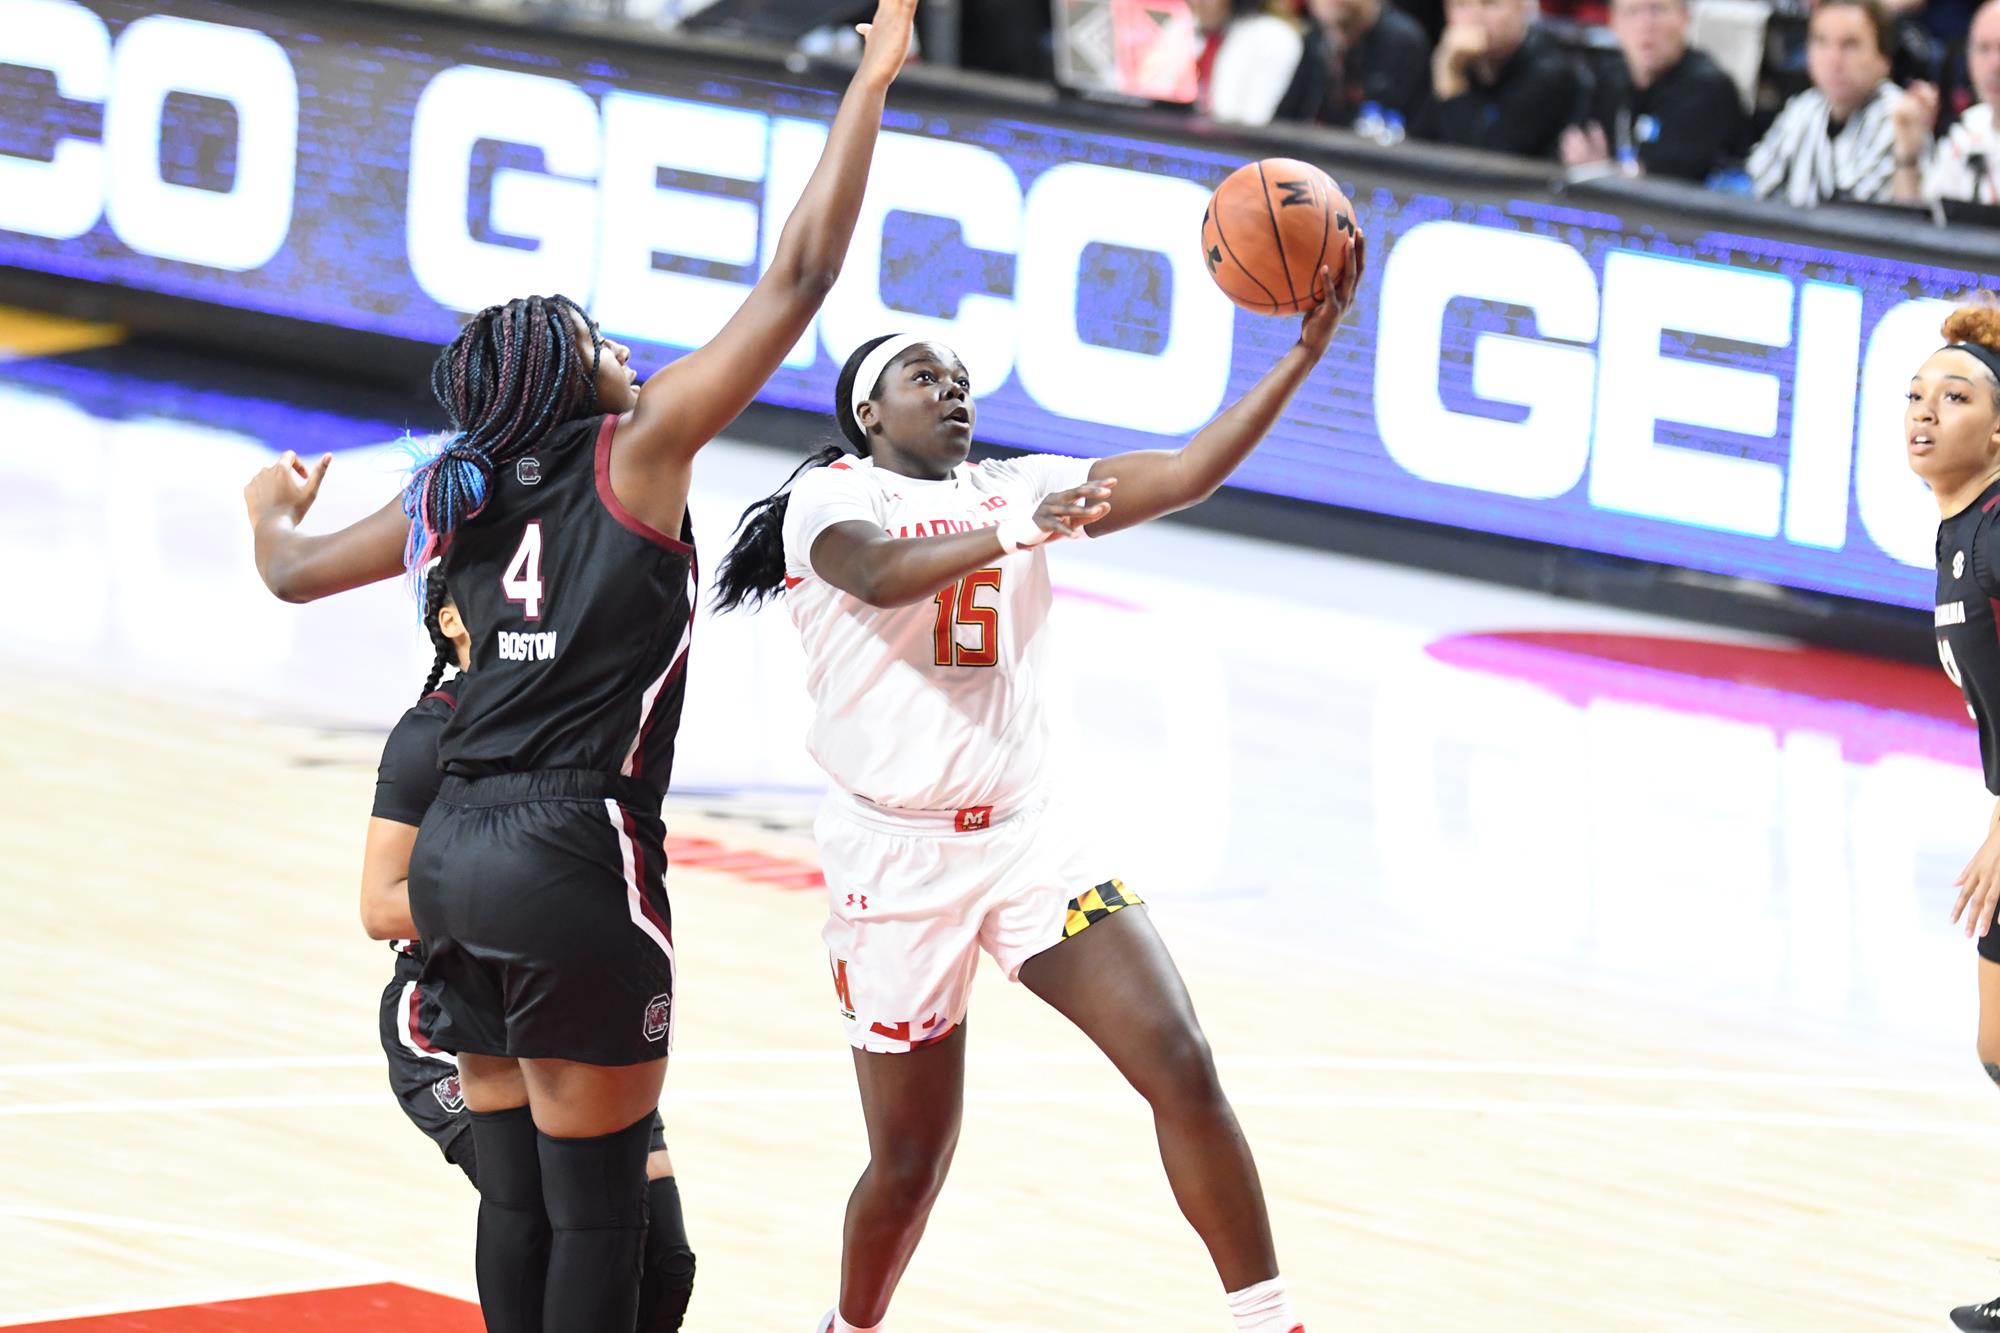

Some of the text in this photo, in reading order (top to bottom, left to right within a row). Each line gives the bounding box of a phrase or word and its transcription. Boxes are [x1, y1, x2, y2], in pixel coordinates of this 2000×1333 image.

[500, 519, 545, 621] 4
[933, 568, 1002, 667] 15
[497, 630, 558, 662] BOSTON
